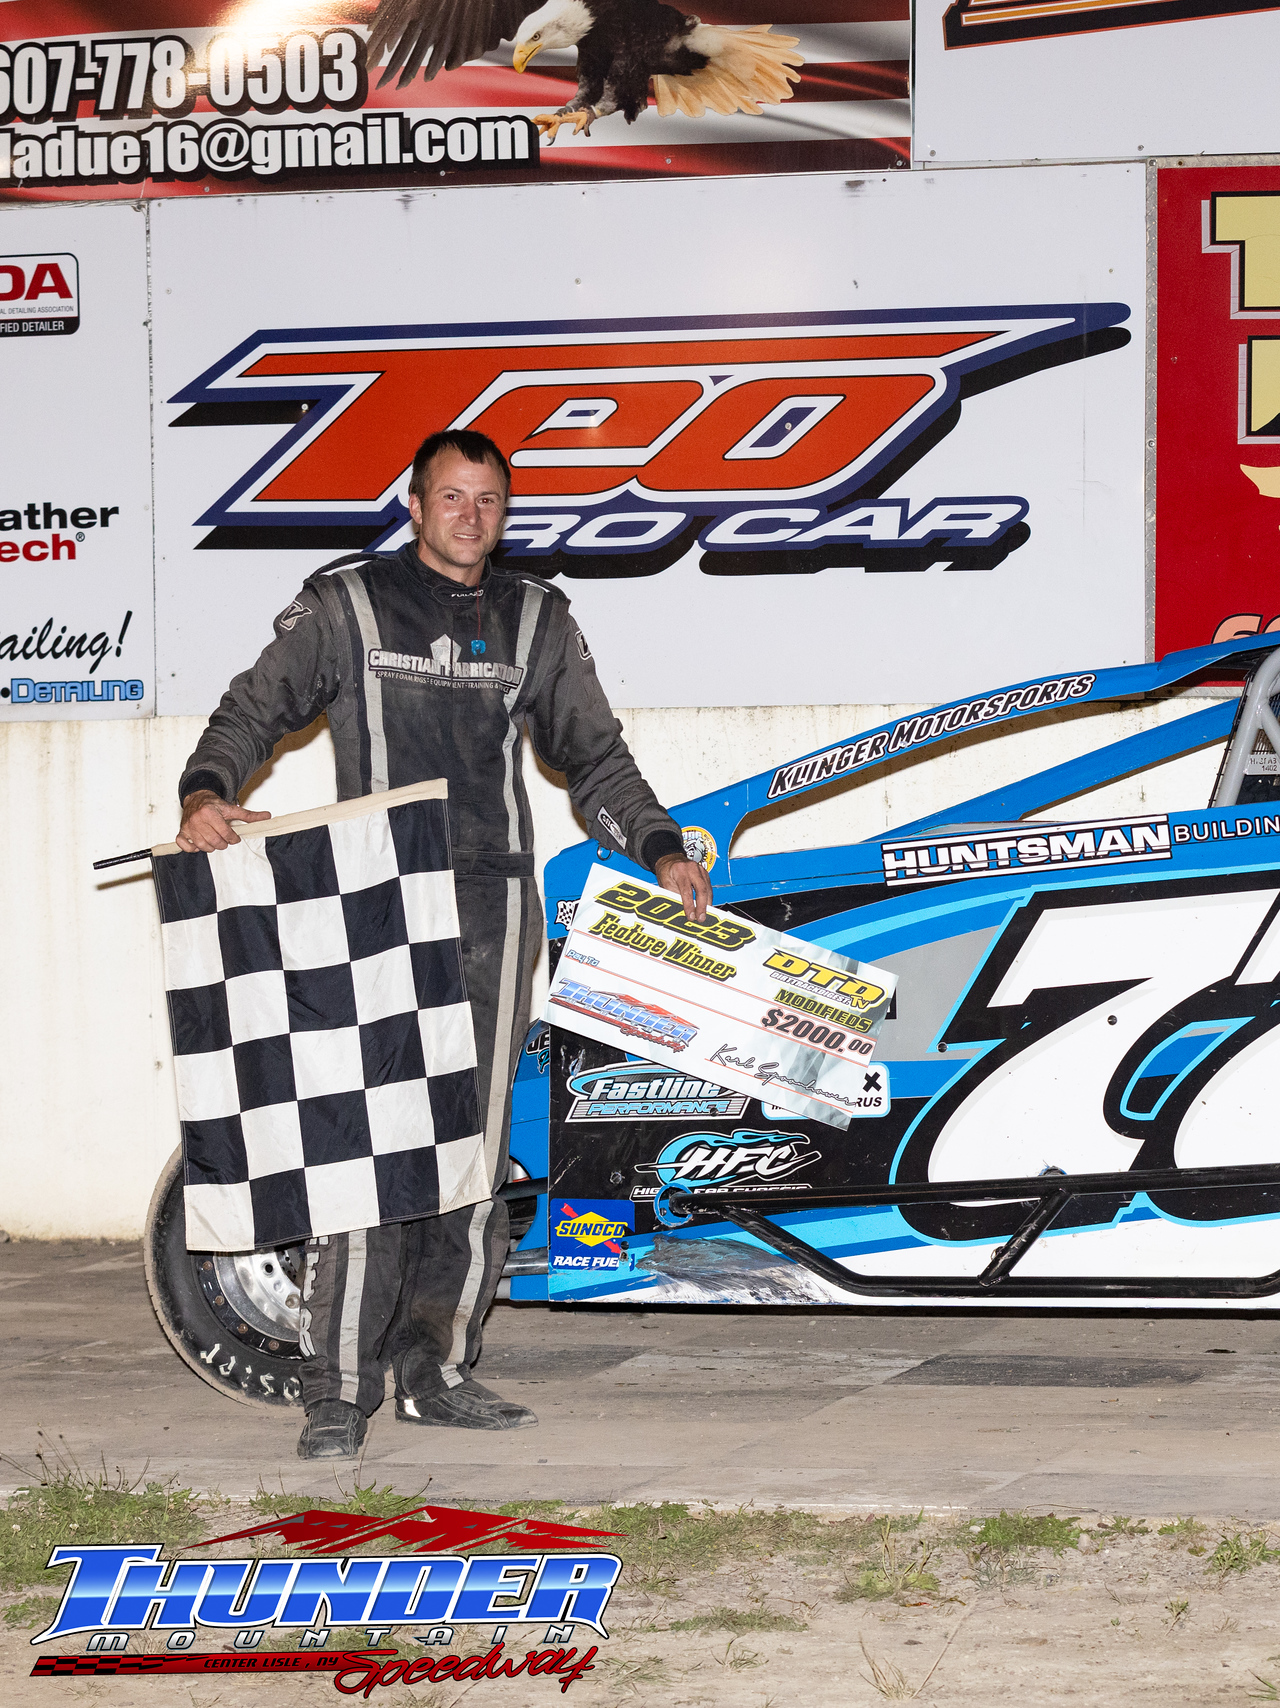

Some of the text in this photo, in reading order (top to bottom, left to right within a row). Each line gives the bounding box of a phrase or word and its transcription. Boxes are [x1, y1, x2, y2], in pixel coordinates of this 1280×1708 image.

[8, 307, 36, 315] DETAILING
[38, 305, 74, 313] ASSOCIATION
[22, 320, 65, 332] DETAILER
[0, 502, 119, 531] ather
[703, 501, 1006, 548] CAR
[369, 650, 523, 685] CHRISTIAN FABRICATION
[377, 670, 395, 680] SPRAY
[396, 672, 412, 682] FOAM
[467, 681, 493, 690] TRAINING
[768, 673, 1097, 798] KLINGER MOTORSPORTS
[884, 823, 1171, 879] HUNTSMAN
[594, 881, 756, 950] 2023
[585, 956, 600, 967] To
[588, 910, 738, 982] Feature Winner
[762, 948, 885, 1004] DTD
[550, 977, 698, 1047] THUNDER
[774, 988, 872, 1033] MODIFIEDS
[589, 1077, 721, 1100] Fastline
[587, 1100, 729, 1116] PERFORMANCE
[674, 1145, 803, 1179] HFC
[557, 1222, 625, 1237] SUNOCO
[553, 1255, 591, 1267] RACE
